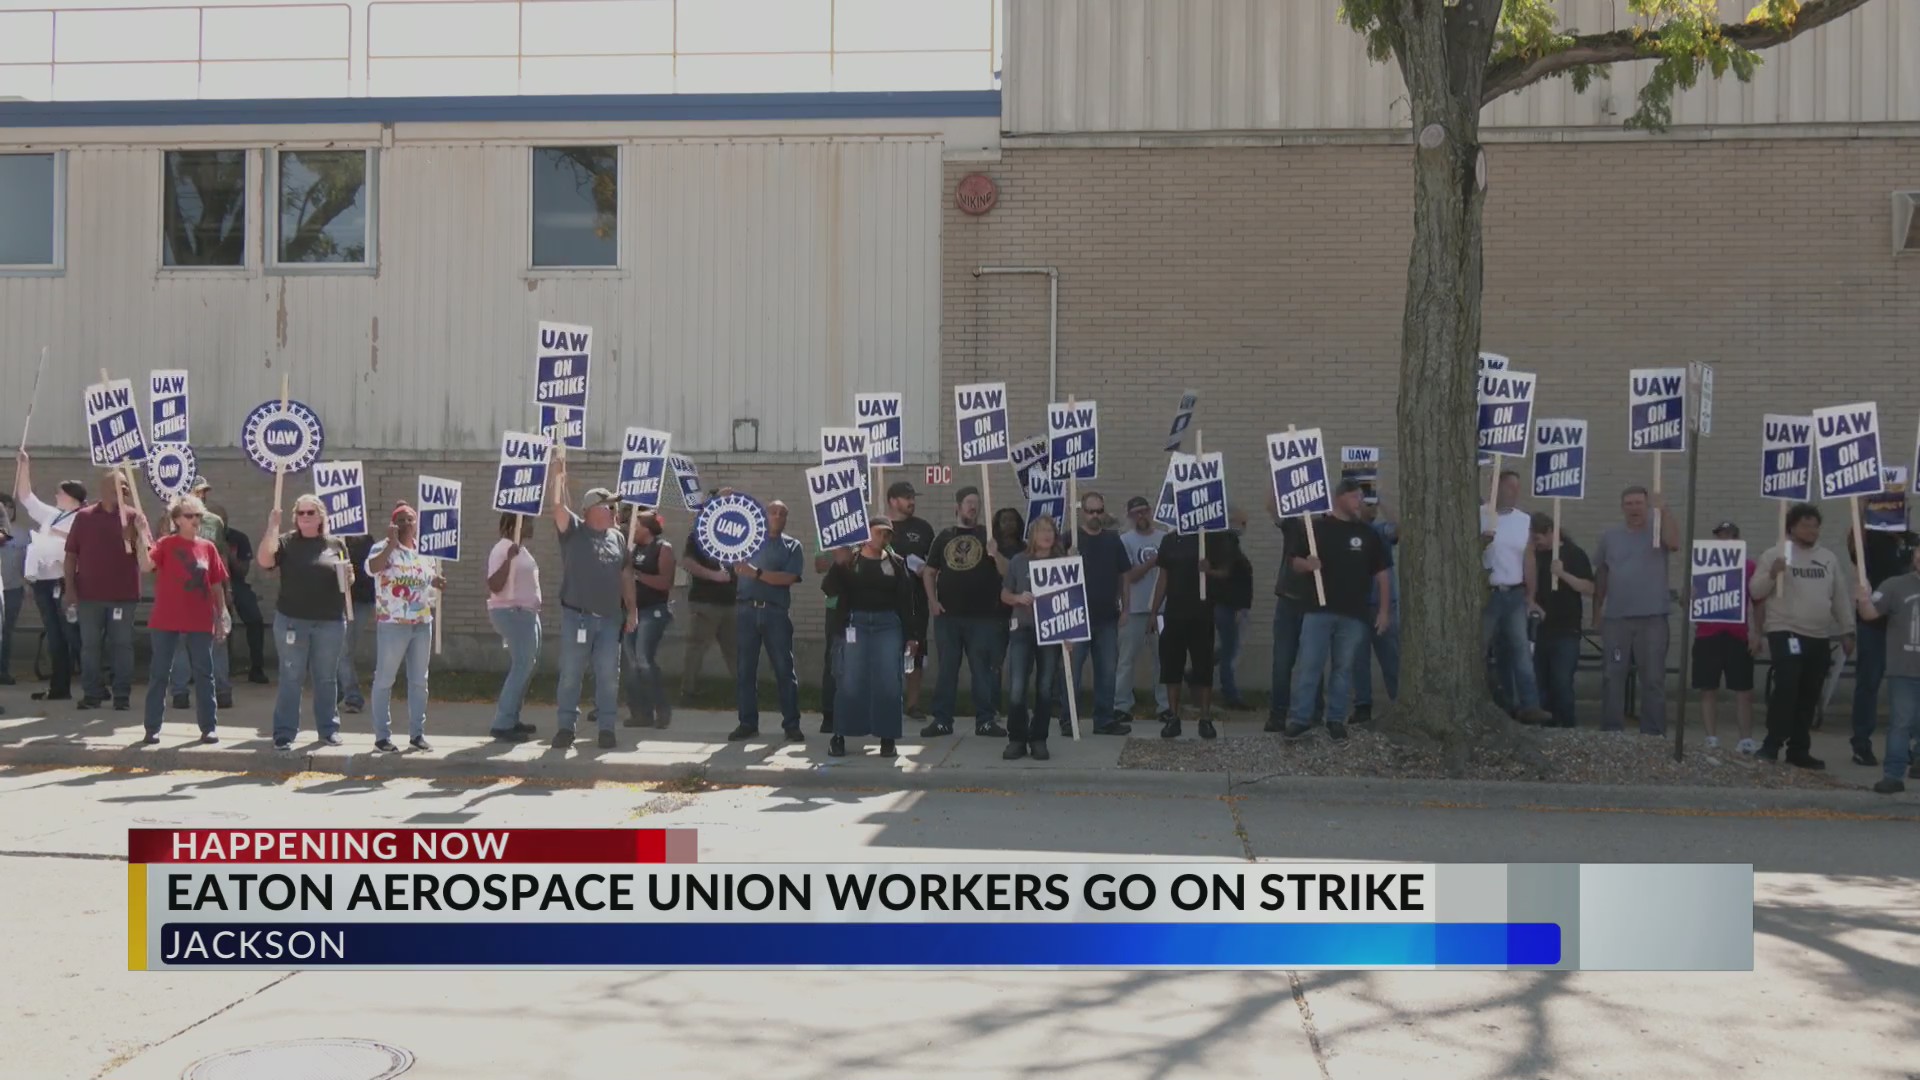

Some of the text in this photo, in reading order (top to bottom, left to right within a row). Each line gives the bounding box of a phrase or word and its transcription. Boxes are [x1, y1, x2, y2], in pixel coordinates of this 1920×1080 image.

[959, 191, 992, 208] VIKING
[541, 329, 588, 351] UAW
[554, 360, 572, 378] ON
[153, 377, 185, 393] UAW
[539, 375, 585, 400] STRIKE
[1483, 377, 1531, 399] UAW
[1633, 376, 1682, 396] UAW
[91, 388, 128, 411] UAW
[162, 400, 176, 418] ON
[858, 399, 898, 416] UAW
[958, 390, 1003, 410] UAW
[1051, 409, 1093, 429] UAW
[1493, 406, 1513, 426] ON
[1647, 403, 1666, 424] ON
[1817, 411, 1872, 438] UAW
[109, 415, 125, 437] ON
[154, 414, 186, 440] STRIKE
[871, 422, 887, 440] ON
[974, 416, 991, 436] ON
[1479, 423, 1525, 447] STRIKE
[1537, 426, 1583, 445] UAW
[1633, 417, 1681, 448] STRIKE
[1766, 422, 1810, 443] UAW
[106, 428, 141, 460] STRIKE
[267, 429, 299, 446] UAW
[626, 434, 666, 455] UAW
[824, 435, 865, 453] UAW
[870, 436, 900, 459] TRIKE
[963, 430, 1005, 459] STRIKE
[1066, 435, 1082, 456] ON
[505, 440, 548, 462] UAW
[1011, 442, 1046, 464] UAW
[1271, 438, 1318, 461] UAW
[1348, 449, 1372, 461] UAW
[1838, 441, 1859, 466] ON
[160, 463, 180, 479] UAW
[633, 461, 650, 479] ON
[1053, 449, 1094, 478] STRIKE
[1174, 460, 1219, 482] UAW
[1550, 451, 1567, 471] ON
[1776, 452, 1794, 471] ON
[316, 468, 359, 487] UAW
[514, 468, 532, 486] ON
[810, 468, 855, 494] UAW
[926, 466, 950, 483] FDC
[1290, 465, 1309, 488] ON
[1535, 467, 1581, 494] STRIKE
[1764, 467, 1807, 493] STRIKE
[1825, 457, 1877, 494] STRIKE
[421, 484, 458, 506] UAW
[498, 484, 542, 506] STRIKE
[620, 477, 660, 497] STRIKE
[1031, 477, 1064, 495] UAW
[1191, 487, 1209, 507] ON
[1280, 479, 1326, 513] STRIKE
[332, 492, 349, 511] ON
[831, 497, 848, 520] ON
[328, 506, 362, 531] TRIKE
[433, 512, 447, 531] ON
[1181, 500, 1223, 531] STRIKE
[716, 518, 747, 538] UAW
[821, 510, 864, 546] STRIKE
[420, 530, 457, 553] STRIKE
[1693, 547, 1742, 567] UAW
[1033, 563, 1080, 588] UAW
[1707, 574, 1726, 594] ON
[1051, 591, 1070, 614] ON
[1693, 590, 1741, 617] STRIKE
[1040, 606, 1085, 639] STRIKE
